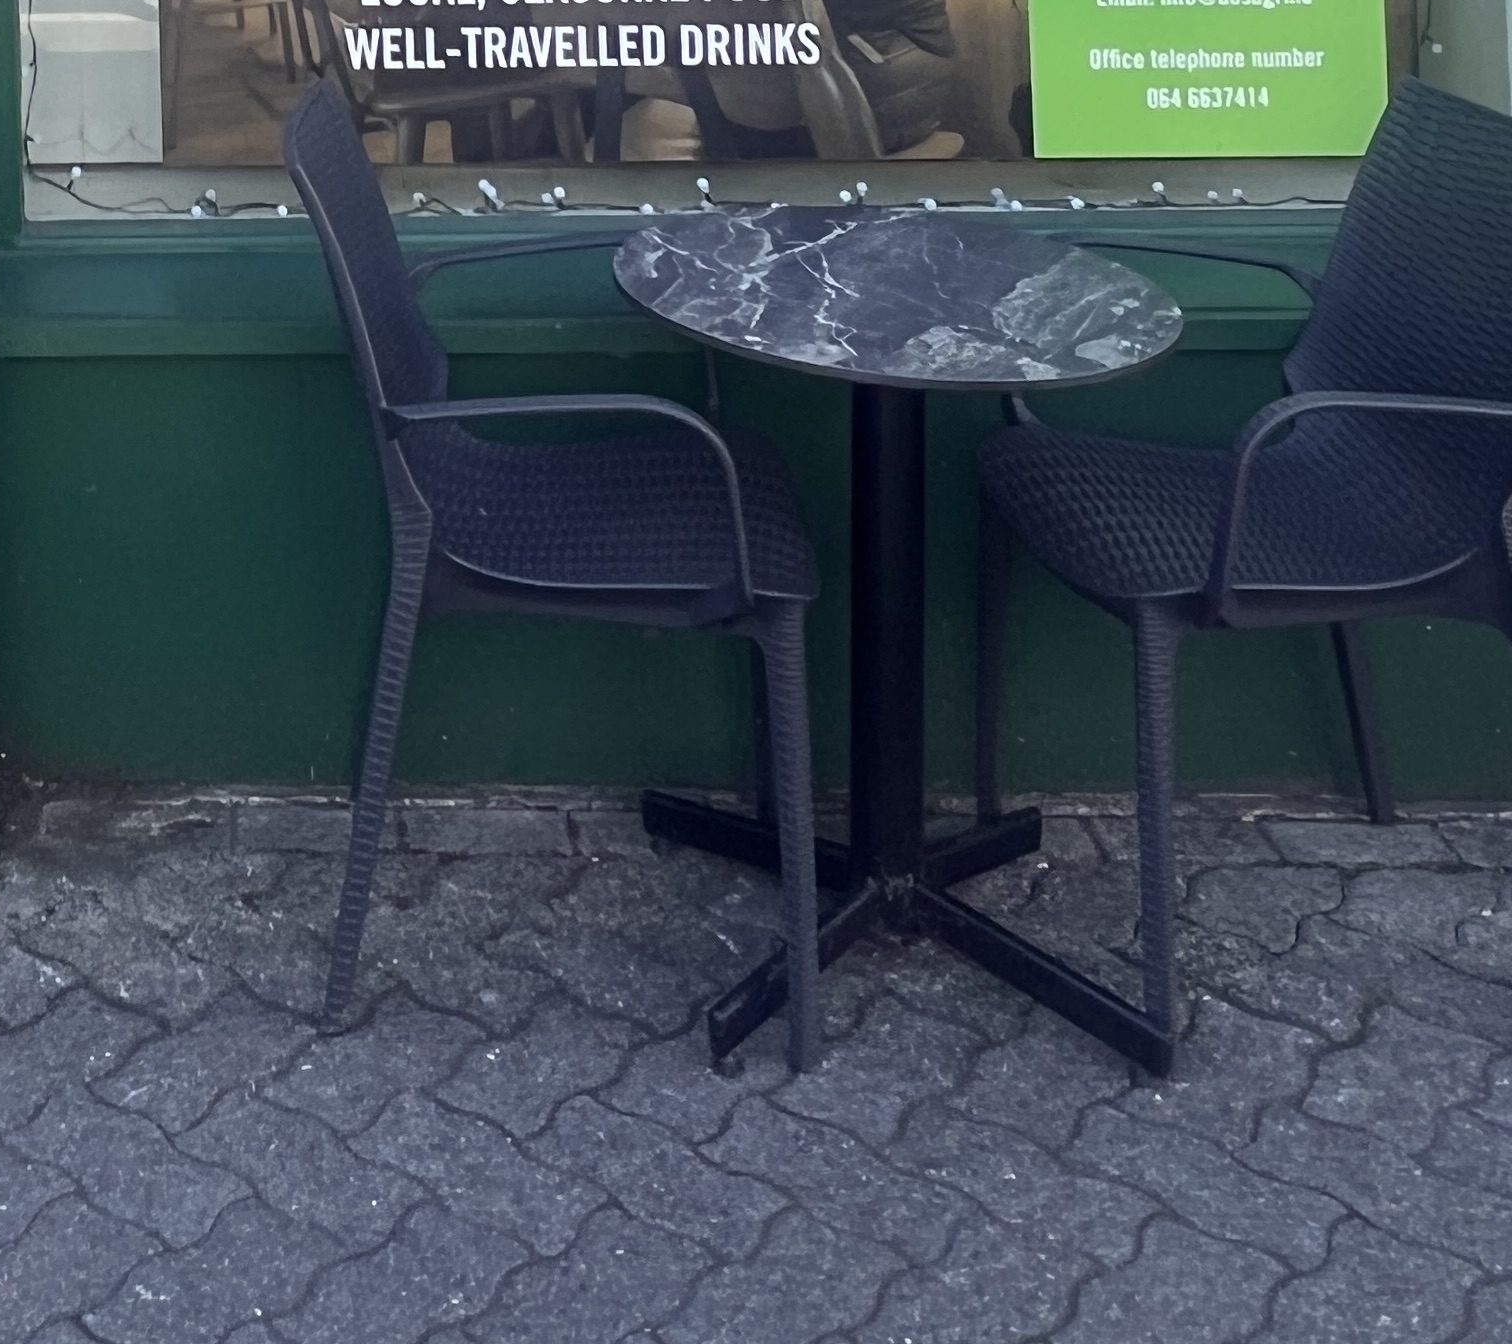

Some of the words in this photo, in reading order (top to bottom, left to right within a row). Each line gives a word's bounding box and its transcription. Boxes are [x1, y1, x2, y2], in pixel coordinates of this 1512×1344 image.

[343, 23, 667, 71] WELL-TRAVELLED
[679, 22, 822, 68] DRINKS
[1089, 48, 1146, 70] Office
[1150, 49, 1246, 72] telephone
[1251, 47, 1326, 69] number
[1146, 87, 1182, 109] 064
[1187, 86, 1270, 109] 6637414
